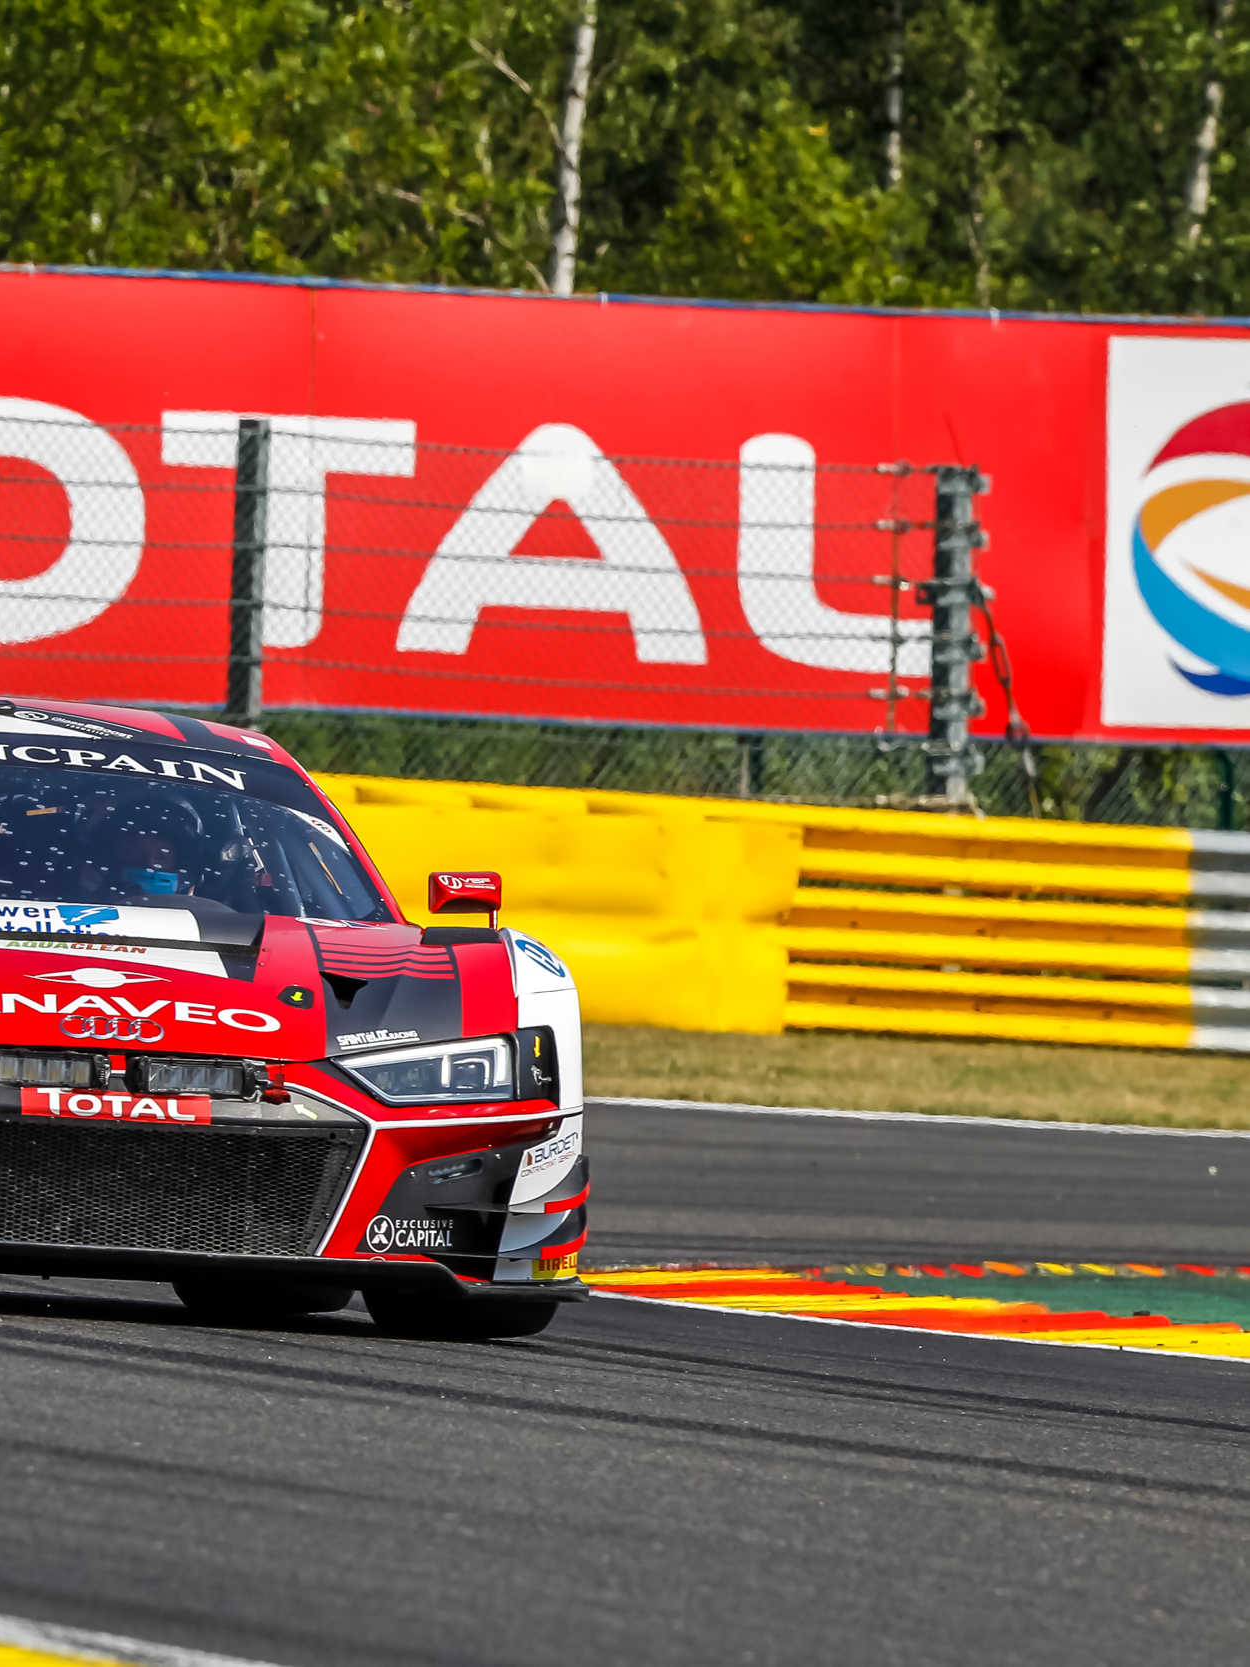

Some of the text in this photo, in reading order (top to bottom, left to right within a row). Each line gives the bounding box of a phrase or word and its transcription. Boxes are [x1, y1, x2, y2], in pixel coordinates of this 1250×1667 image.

[7, 940, 147, 954] AQUACLEAN
[37, 1087, 196, 1121] TOTAL
[395, 1219, 454, 1229] EXCLUSIVE
[395, 1229, 453, 1247] CAPITAL
